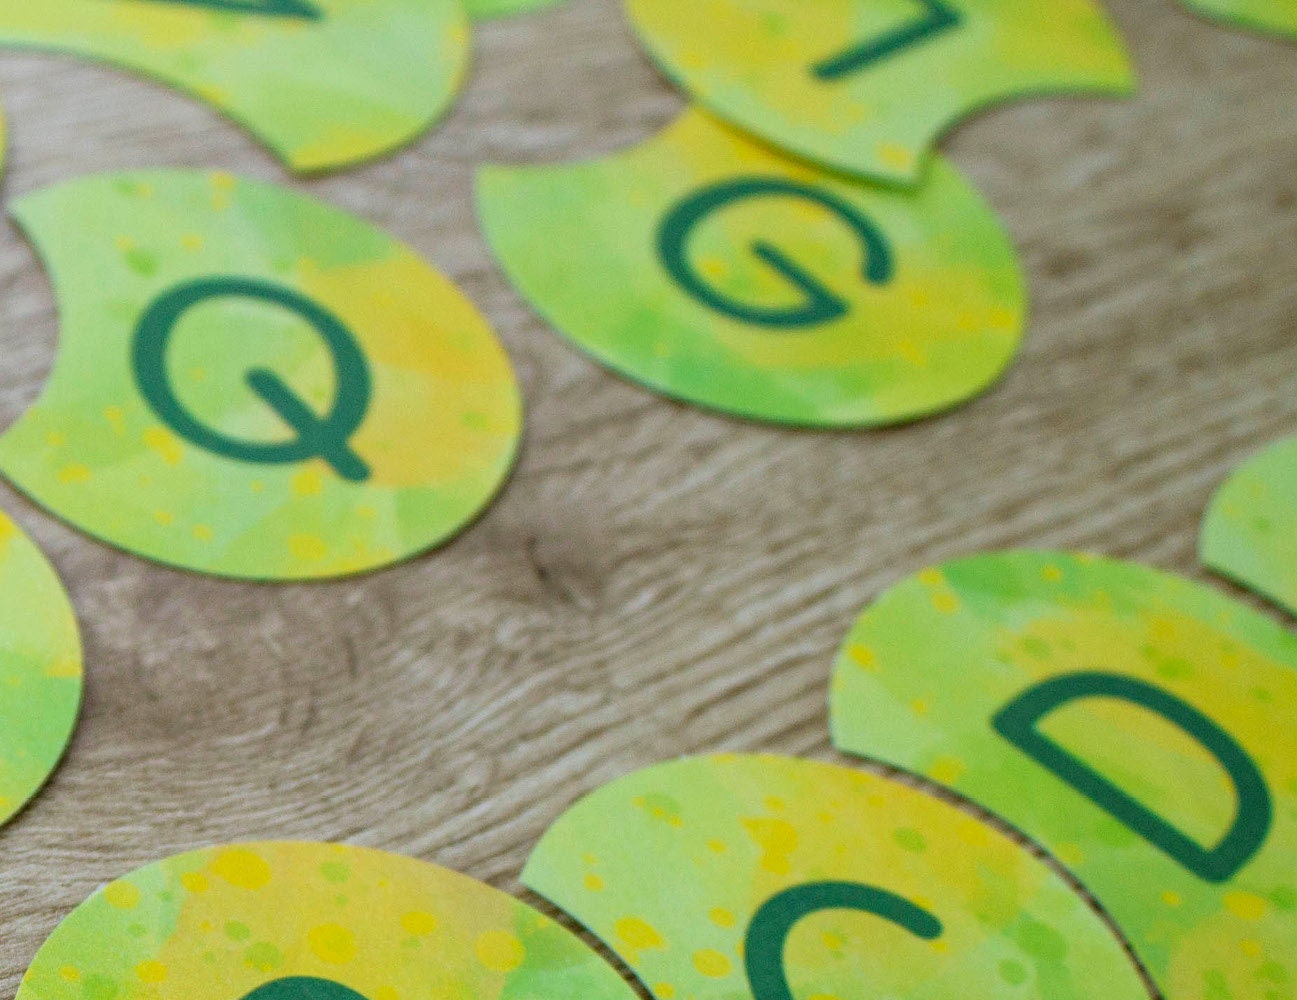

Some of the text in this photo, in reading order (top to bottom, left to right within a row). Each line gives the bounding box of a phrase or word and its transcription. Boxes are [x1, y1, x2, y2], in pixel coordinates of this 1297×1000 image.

[653, 176, 896, 332] G
[130, 275, 373, 484] Q
[988, 669, 1276, 888] D
